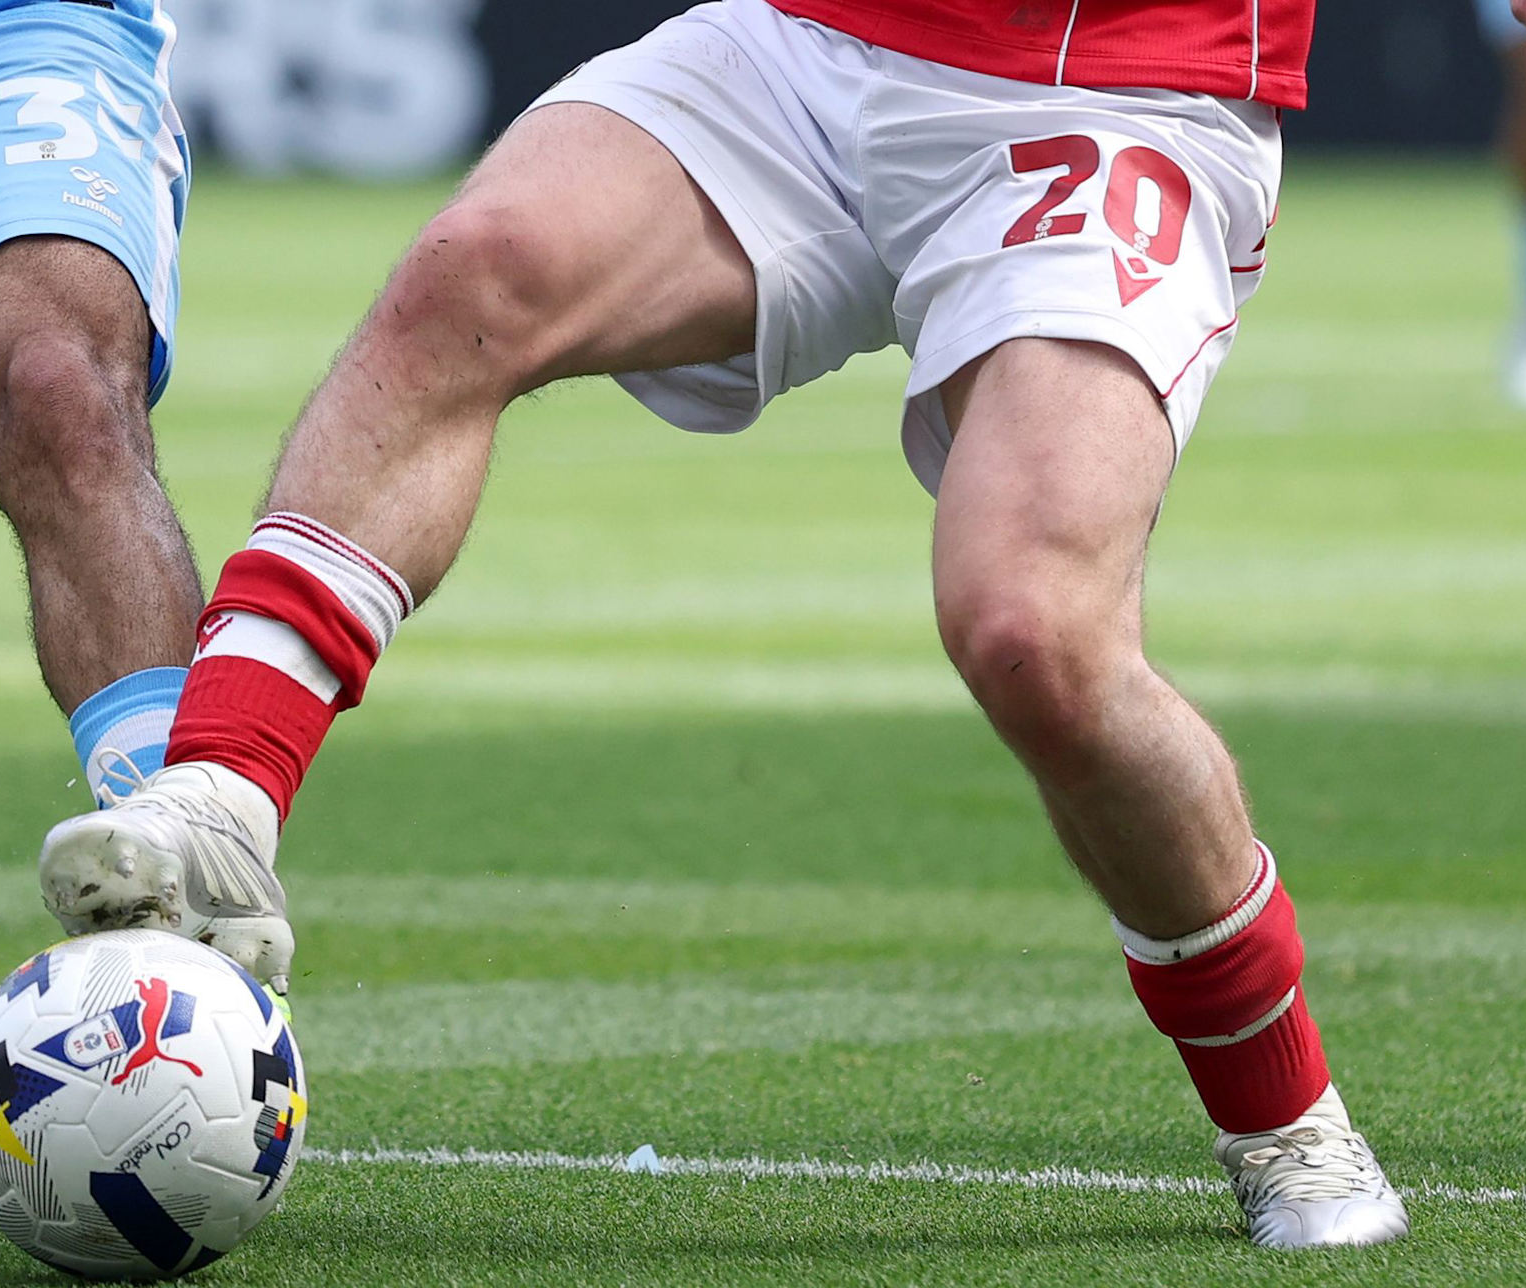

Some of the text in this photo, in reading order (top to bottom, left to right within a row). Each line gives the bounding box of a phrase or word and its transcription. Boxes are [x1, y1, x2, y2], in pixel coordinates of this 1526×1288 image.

[62, 191, 124, 227] hummel
[1002, 134, 1192, 265] 20
[1034, 230, 1049, 240] EFL
